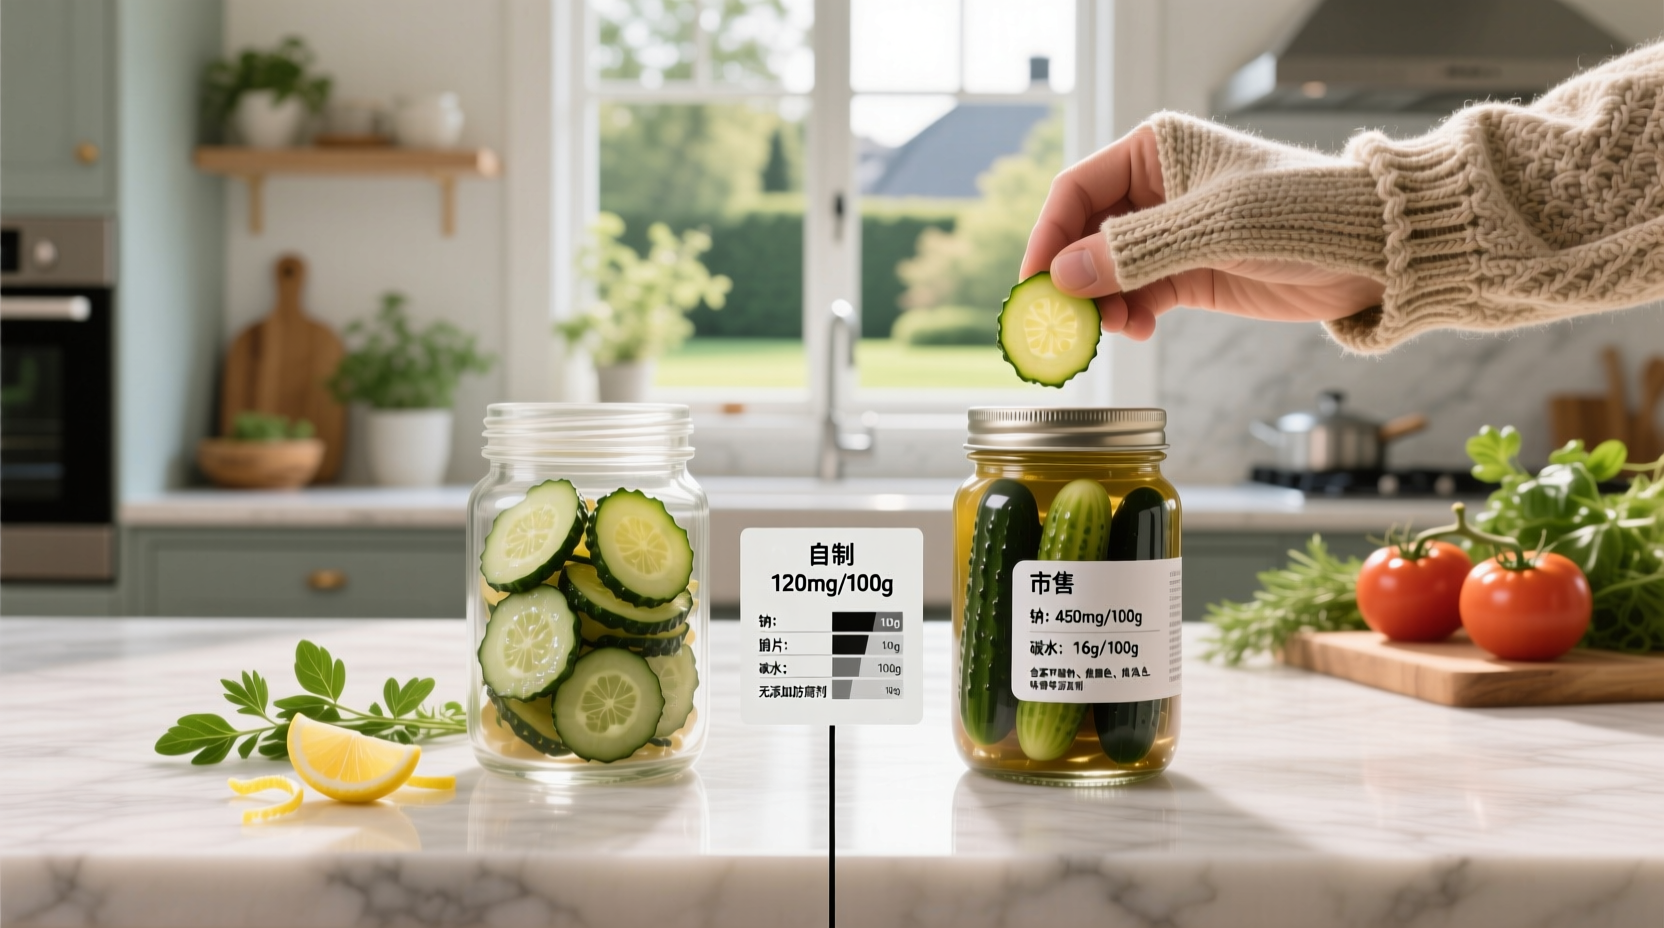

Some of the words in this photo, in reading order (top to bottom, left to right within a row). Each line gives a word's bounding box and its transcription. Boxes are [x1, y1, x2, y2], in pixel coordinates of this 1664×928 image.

[810, 542, 854, 566] 自制
[771, 573, 893, 597] 120mg/100g
[1030, 571, 1074, 595] 市售
[1055, 609, 1142, 627] 450mg/100g
[882, 641, 900, 653] 10g
[1073, 640, 1139, 658] 16g/100g
[878, 663, 901, 676] 100g
